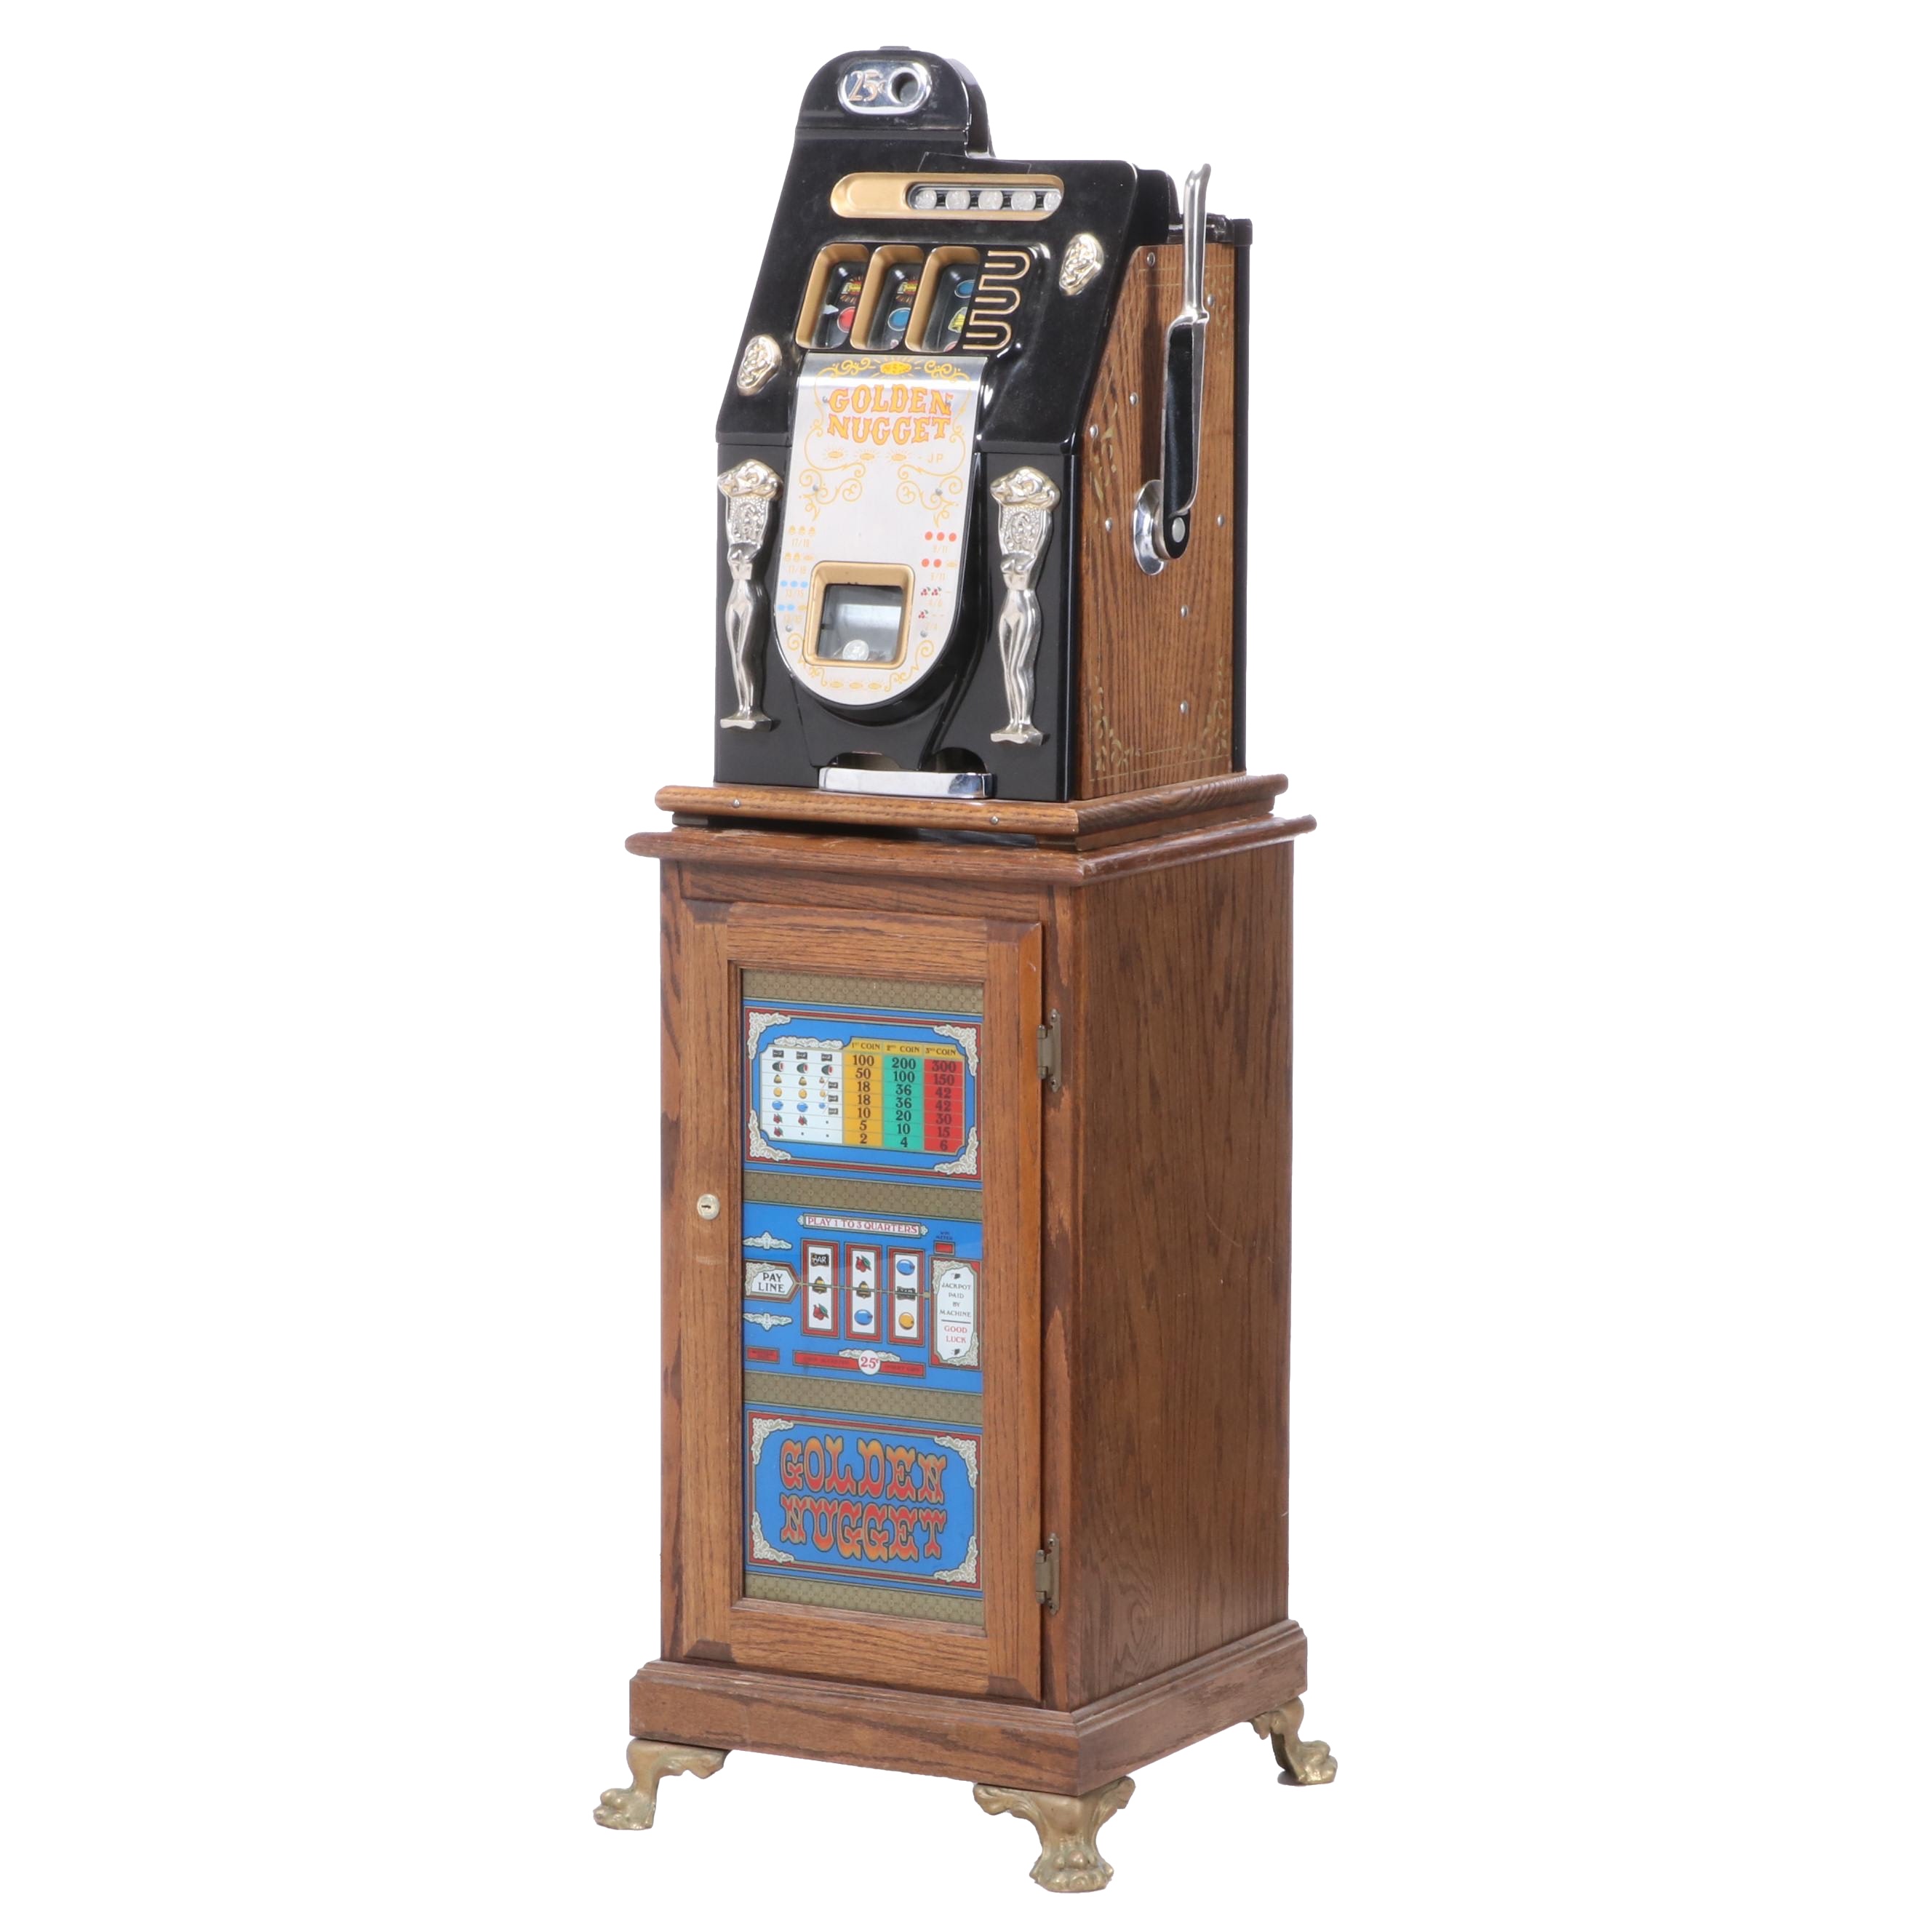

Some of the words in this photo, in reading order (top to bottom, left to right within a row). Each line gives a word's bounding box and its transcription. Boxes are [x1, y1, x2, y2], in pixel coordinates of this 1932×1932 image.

[828, 384, 953, 416] GOLDEN
[827, 413, 951, 446] NUGGET
[861, 1042, 880, 1050] COIN
[853, 1055, 874, 1066] 100
[892, 1057, 916, 1069] 200
[932, 1060, 957, 1072] 300
[855, 1068, 871, 1079] 50
[894, 1071, 915, 1082] 100
[934, 1073, 954, 1085] 150
[857, 1082, 870, 1093] 18
[895, 1084, 911, 1095] 36
[935, 1087, 951, 1099] 42
[858, 1094, 871, 1105] 18
[895, 1097, 912, 1109] 36
[935, 1099, 951, 1111] 42
[858, 1107, 871, 1119] 10
[895, 1110, 911, 1122] 20
[935, 1113, 951, 1125] 30
[859, 1120, 867, 1130] 5
[897, 1124, 910, 1135] 10
[938, 1127, 950, 1138] 15
[860, 1133, 867, 1144] 2
[900, 1137, 908, 1148] 4
[940, 1140, 948, 1151] 6
[807, 1217, 831, 1226] PLAY
[841, 1220, 855, 1229] TO
[863, 1223, 918, 1234] QUARTERS
[812, 1256, 827, 1264] BAR
[763, 1273, 783, 1282] PAY
[758, 1282, 786, 1293] LINE
[942, 1282, 971, 1290] JACKPOT
[940, 1309, 972, 1317] MACHINE
[943, 1325, 967, 1334] GOOD
[780, 1434, 947, 1505] GOLDEN
[780, 1493, 947, 1562] NUGGET
